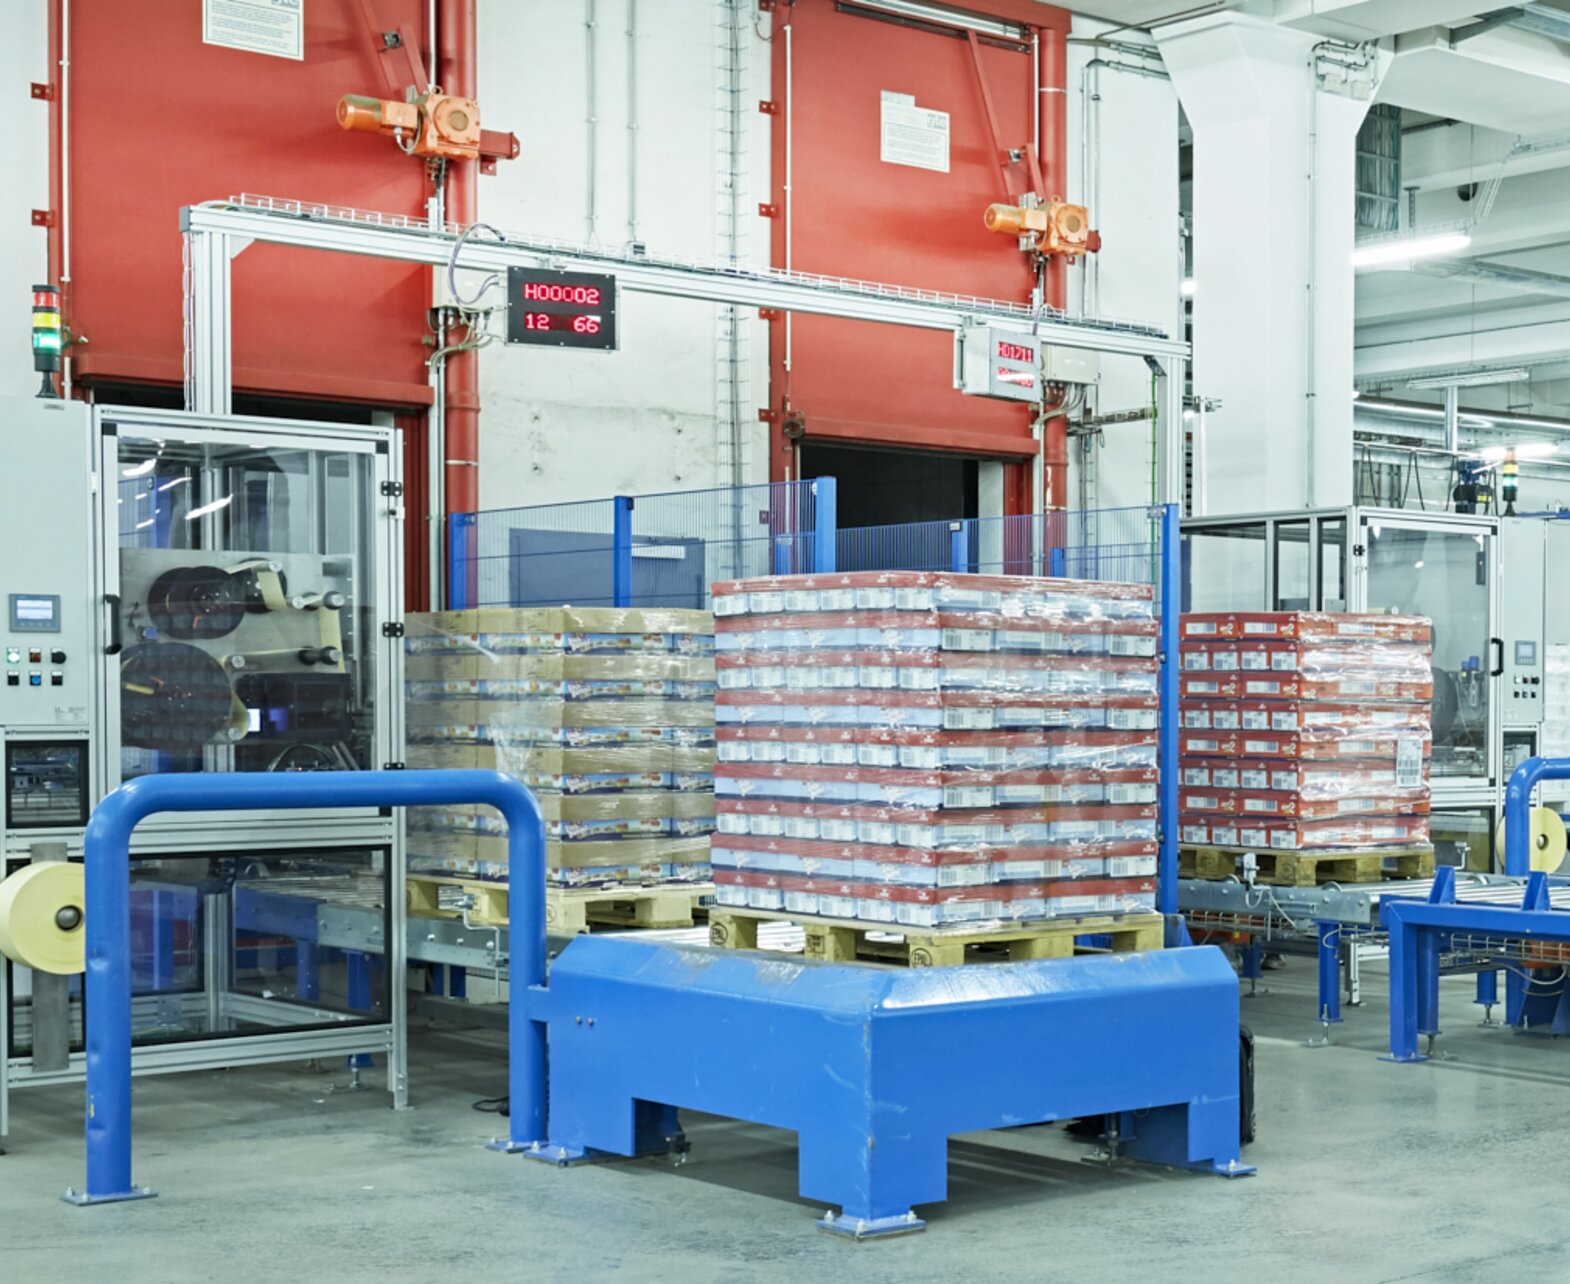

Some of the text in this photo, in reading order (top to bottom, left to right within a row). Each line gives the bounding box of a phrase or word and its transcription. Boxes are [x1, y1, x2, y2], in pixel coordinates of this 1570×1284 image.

[524, 283, 600, 304] H00002
[525, 313, 599, 333] 12 66
